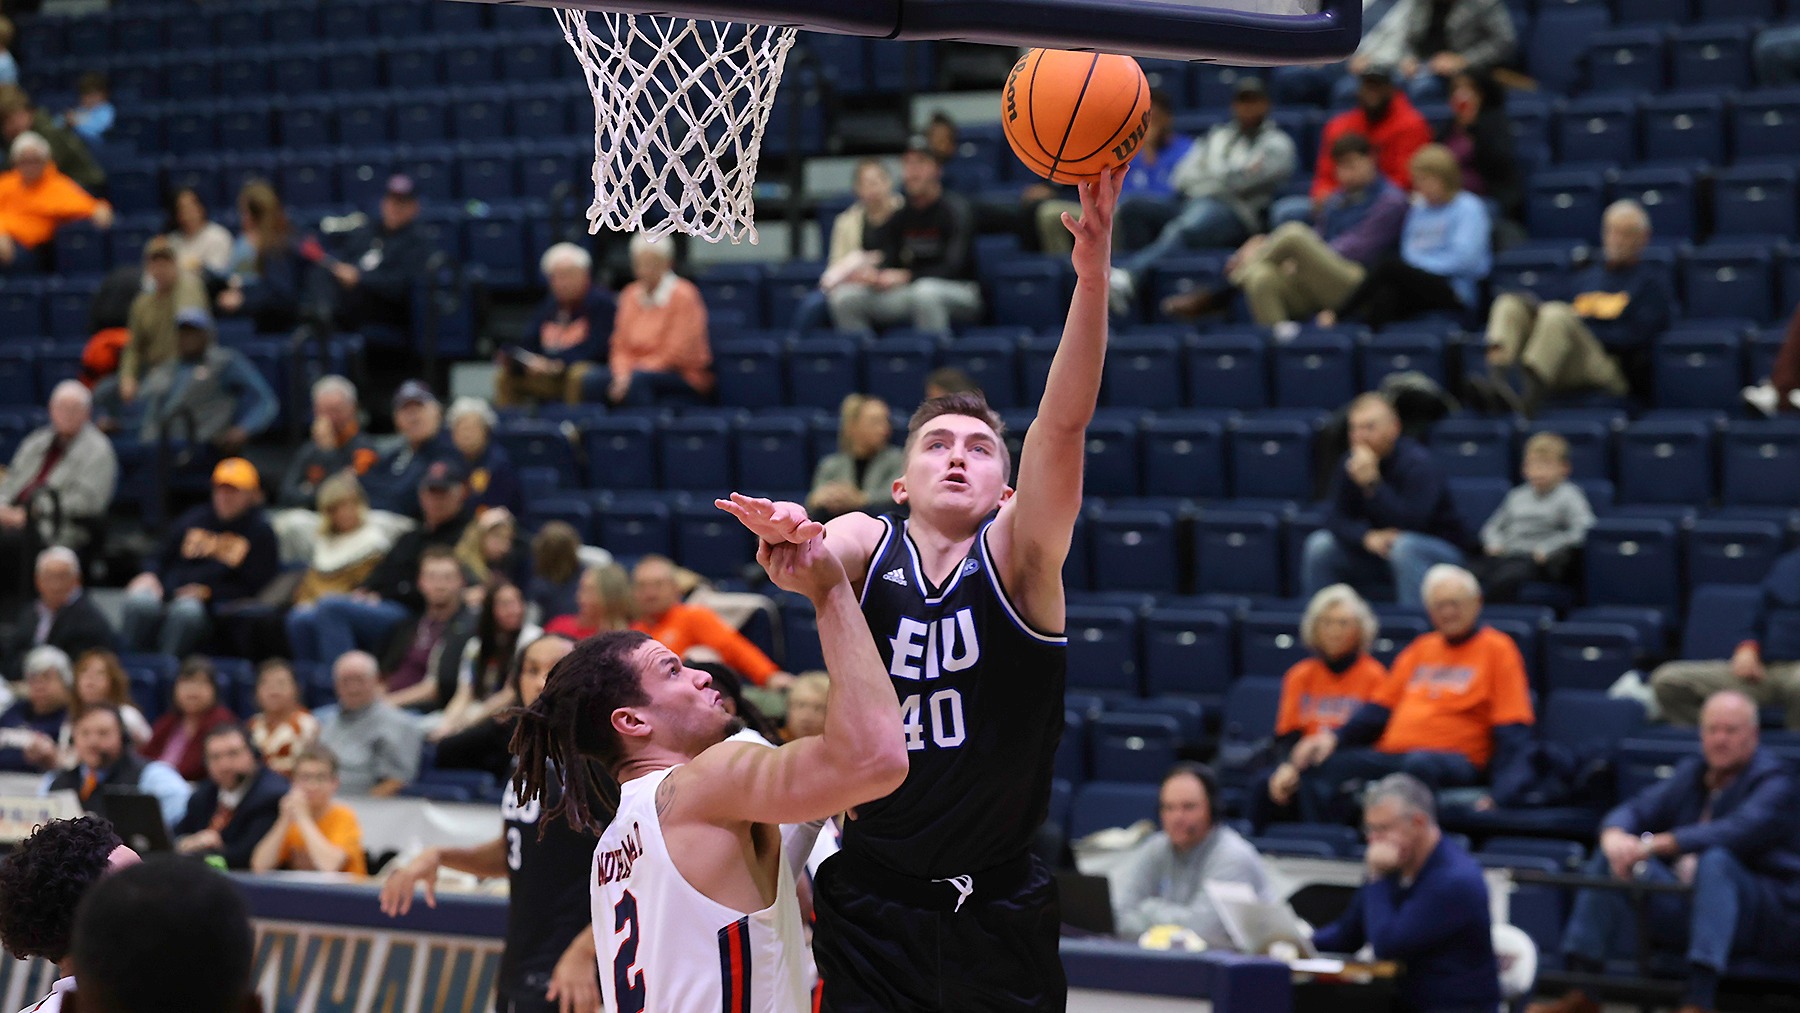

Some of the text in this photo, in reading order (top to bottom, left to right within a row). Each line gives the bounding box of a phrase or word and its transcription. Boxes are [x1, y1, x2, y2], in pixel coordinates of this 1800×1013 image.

[1112, 108, 1151, 161] Wil
[889, 608, 980, 680] EIU
[900, 688, 966, 751] 40
[613, 888, 646, 1013] 2
